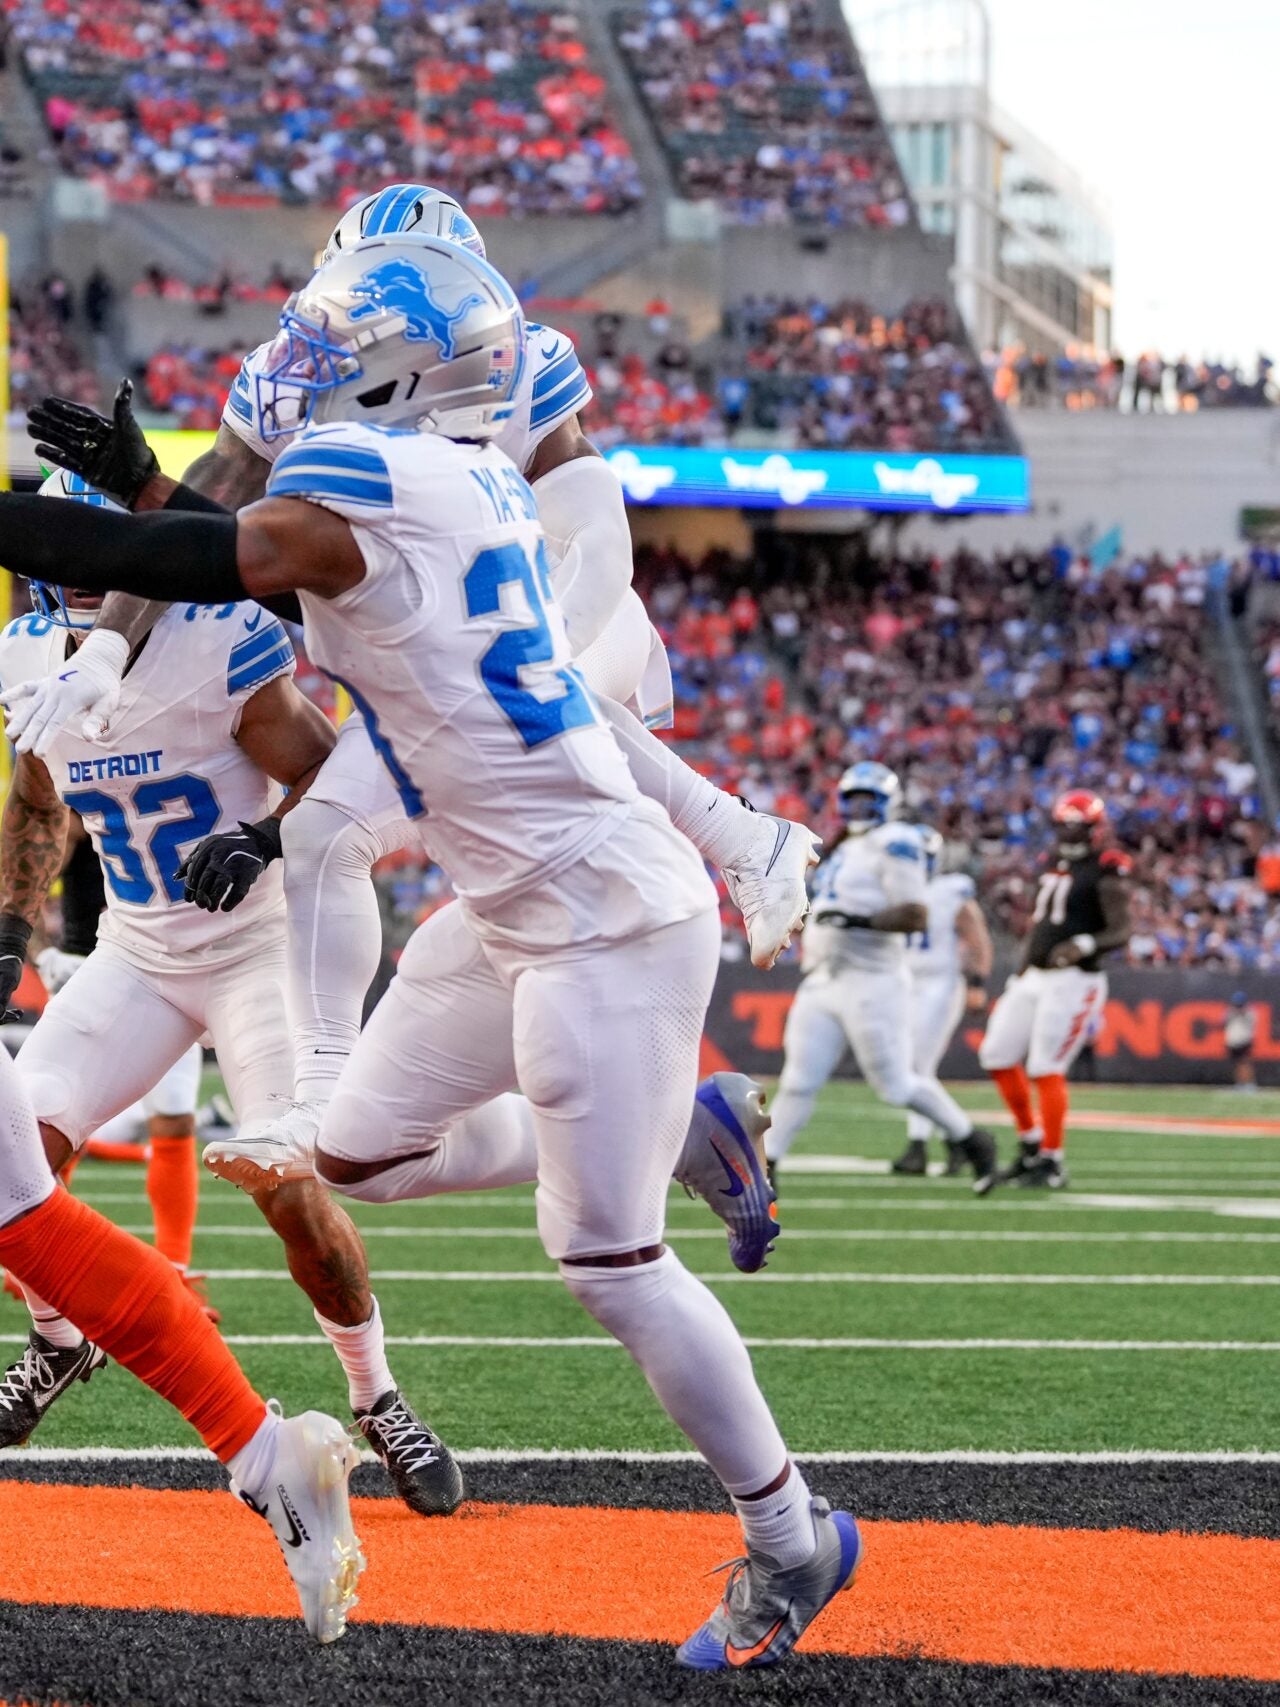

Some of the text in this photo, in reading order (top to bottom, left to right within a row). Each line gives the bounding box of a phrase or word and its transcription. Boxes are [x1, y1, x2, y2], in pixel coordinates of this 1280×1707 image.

[457, 534, 601, 752] 2
[67, 749, 164, 784] DETROIT
[61, 770, 224, 908] 32
